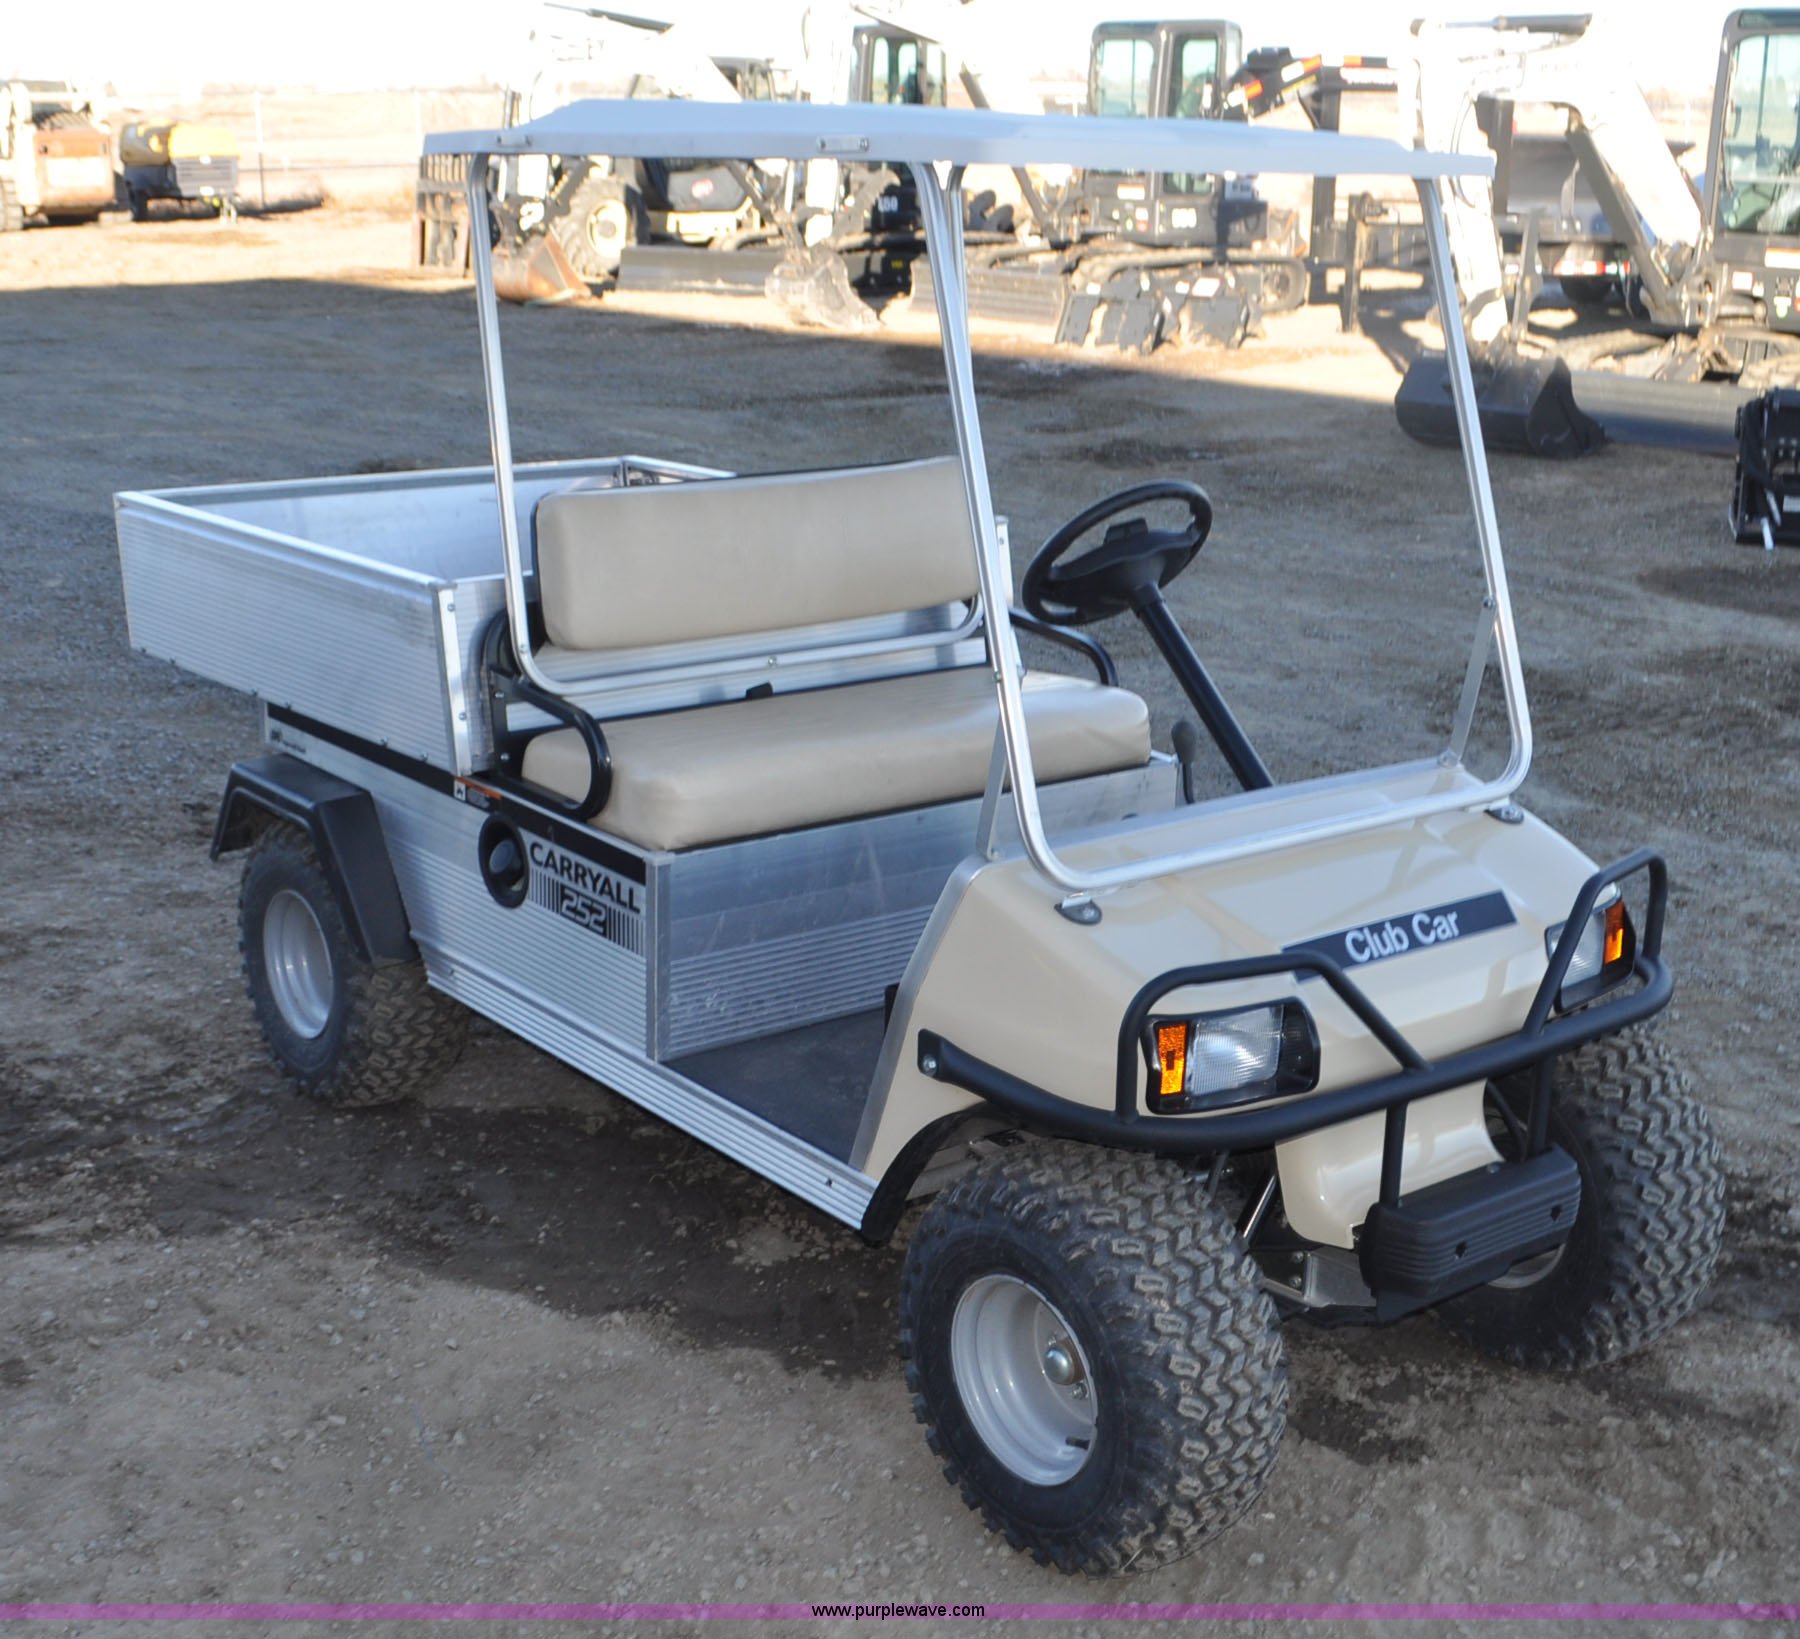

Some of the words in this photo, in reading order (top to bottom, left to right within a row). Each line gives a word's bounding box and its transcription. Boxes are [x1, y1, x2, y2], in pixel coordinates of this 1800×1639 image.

[529, 841, 641, 915] CARRYALL
[560, 889, 608, 935] 252
[1345, 921, 1410, 963] Club
[1411, 911, 1460, 945] Car
